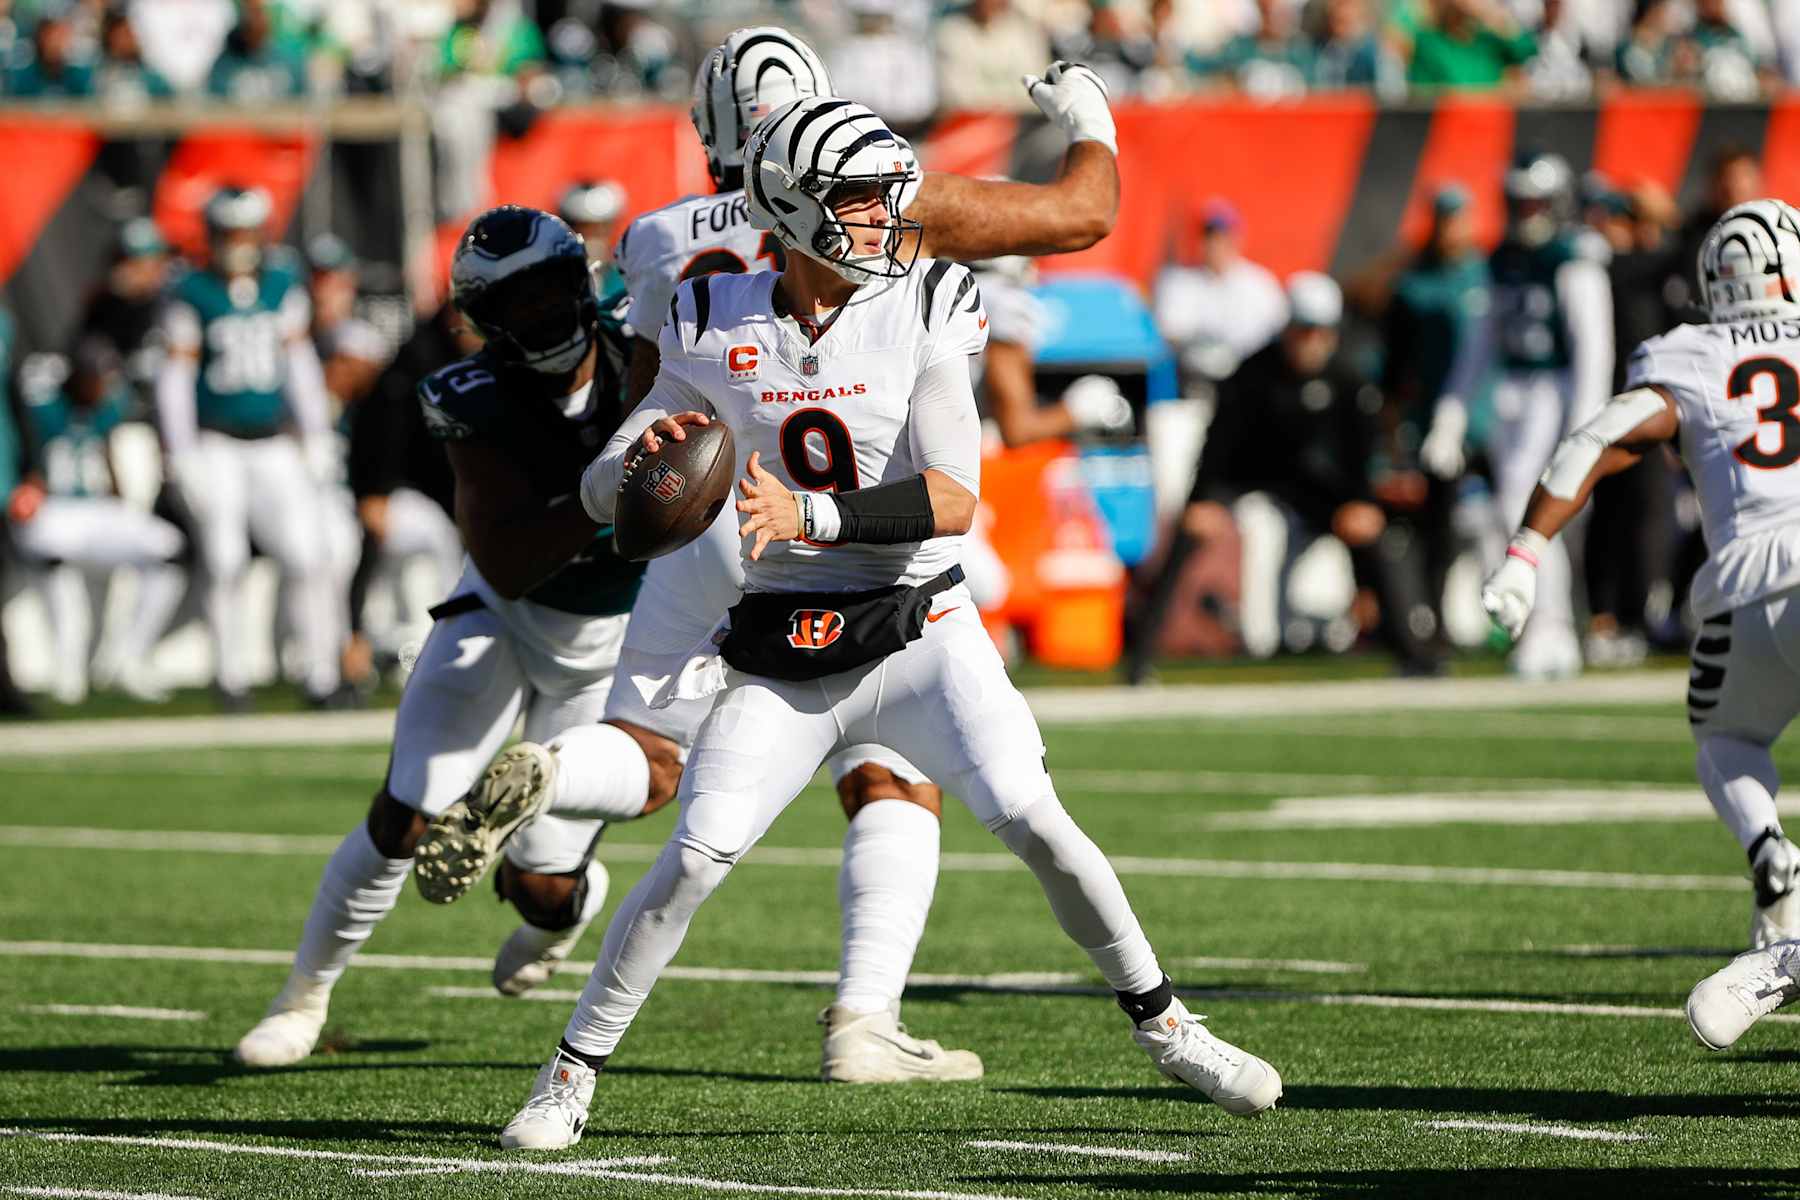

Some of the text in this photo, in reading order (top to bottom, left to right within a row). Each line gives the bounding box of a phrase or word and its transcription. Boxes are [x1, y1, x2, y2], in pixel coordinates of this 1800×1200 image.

[728, 346, 759, 372] C
[761, 383, 867, 402] BENGALS
[1727, 354, 1800, 470] 3
[656, 473, 682, 498] NFL
[779, 407, 860, 548] 9
